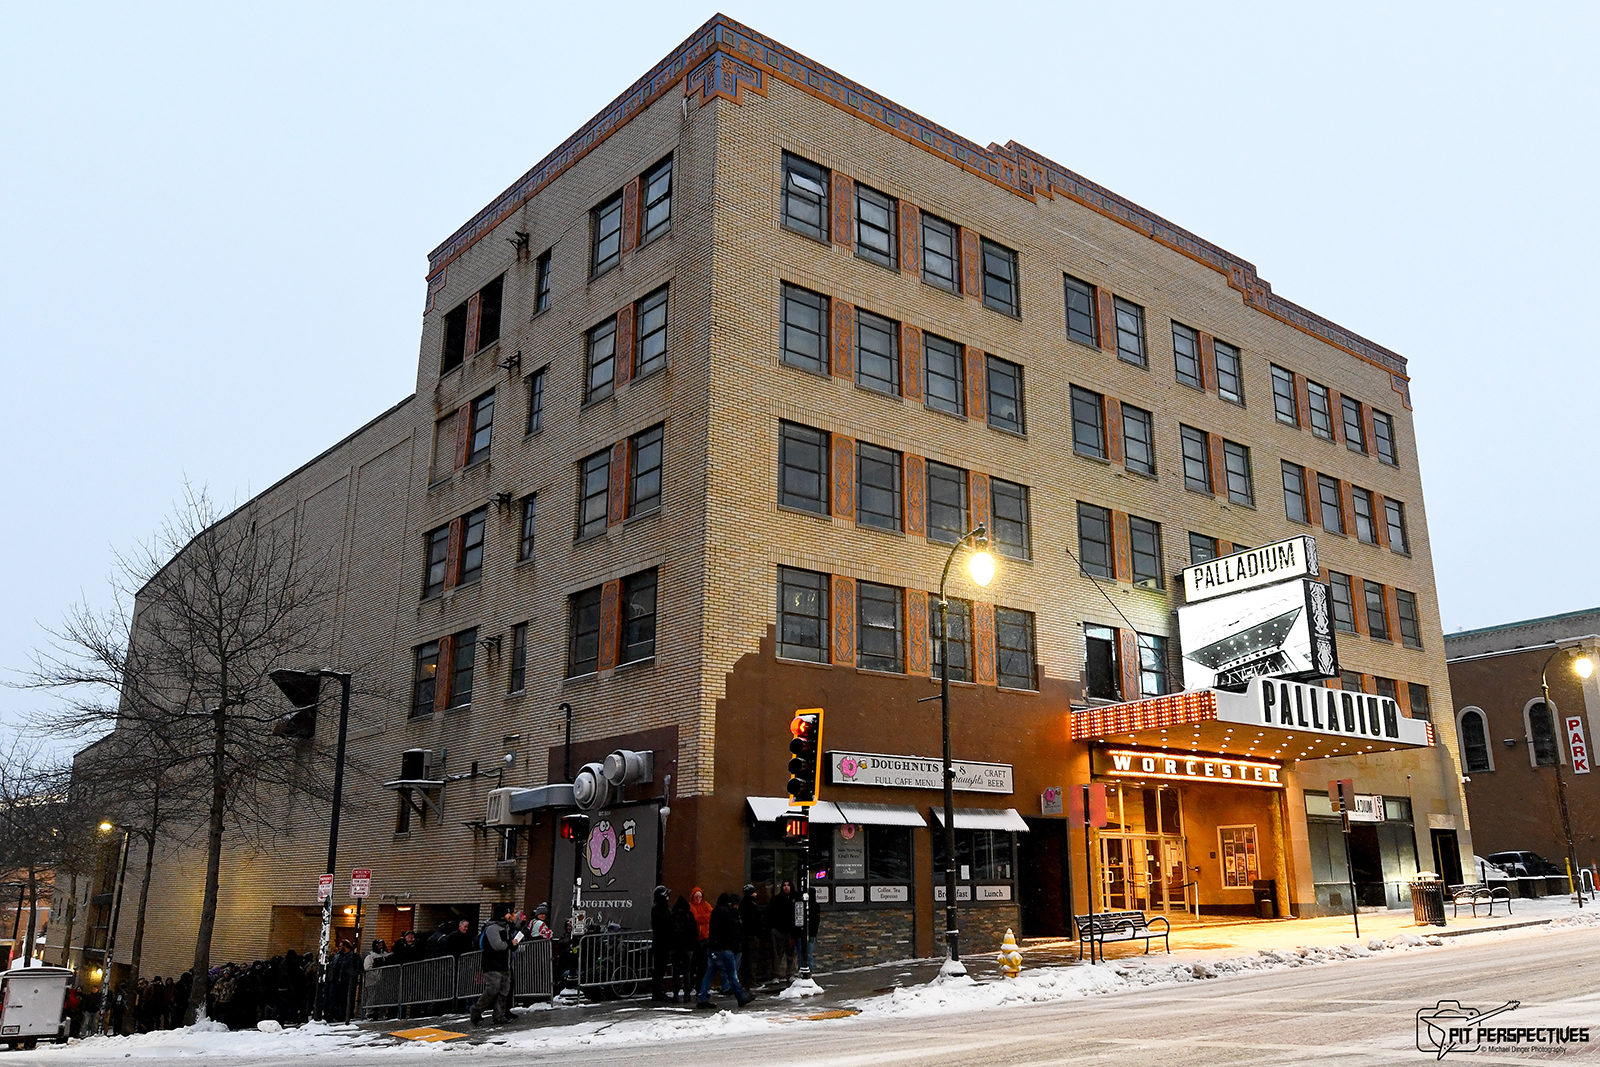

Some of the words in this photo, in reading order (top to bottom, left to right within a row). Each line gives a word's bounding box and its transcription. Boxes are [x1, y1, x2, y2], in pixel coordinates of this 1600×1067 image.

[1194, 542, 1296, 591] PALLADIUM
[1262, 680, 1400, 739] PALLADIUM
[1568, 719, 1588, 770] PARK
[871, 758, 939, 773] DOUGHNUTS
[1112, 755, 1278, 783] WORCESTER
[941, 771, 984, 788] raughts
[984, 769, 1006, 778] CRAFT
[875, 776, 893, 785] FULL
[894, 777, 913, 786] CAFE
[914, 778, 936, 787] MENU
[987, 779, 1005, 788] BEER
[984, 889, 1003, 898] Lunch
[571, 899, 633, 908] OUGHNUTS
